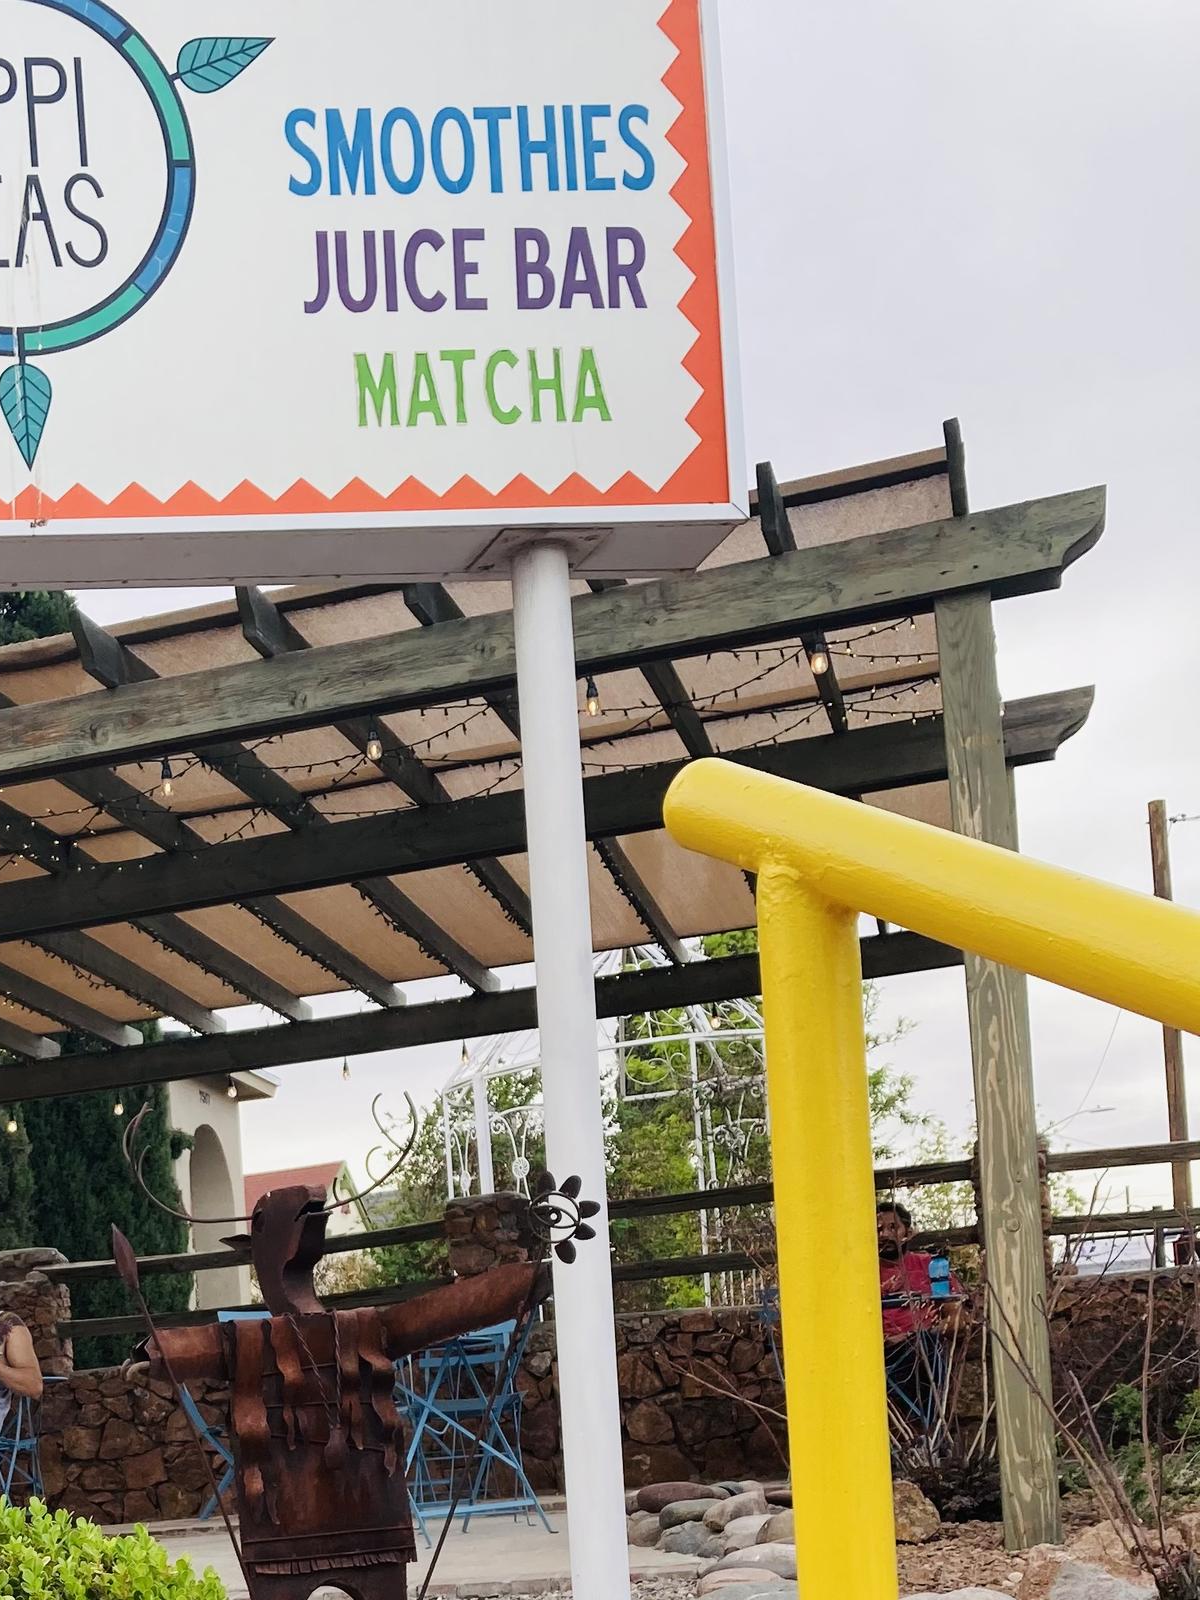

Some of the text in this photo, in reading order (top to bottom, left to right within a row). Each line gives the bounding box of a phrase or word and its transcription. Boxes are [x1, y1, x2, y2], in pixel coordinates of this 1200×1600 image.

[284, 103, 656, 197] SMOOTHIES
[304, 226, 648, 314] JUICE BAR
[354, 348, 612, 428] MATCHA
